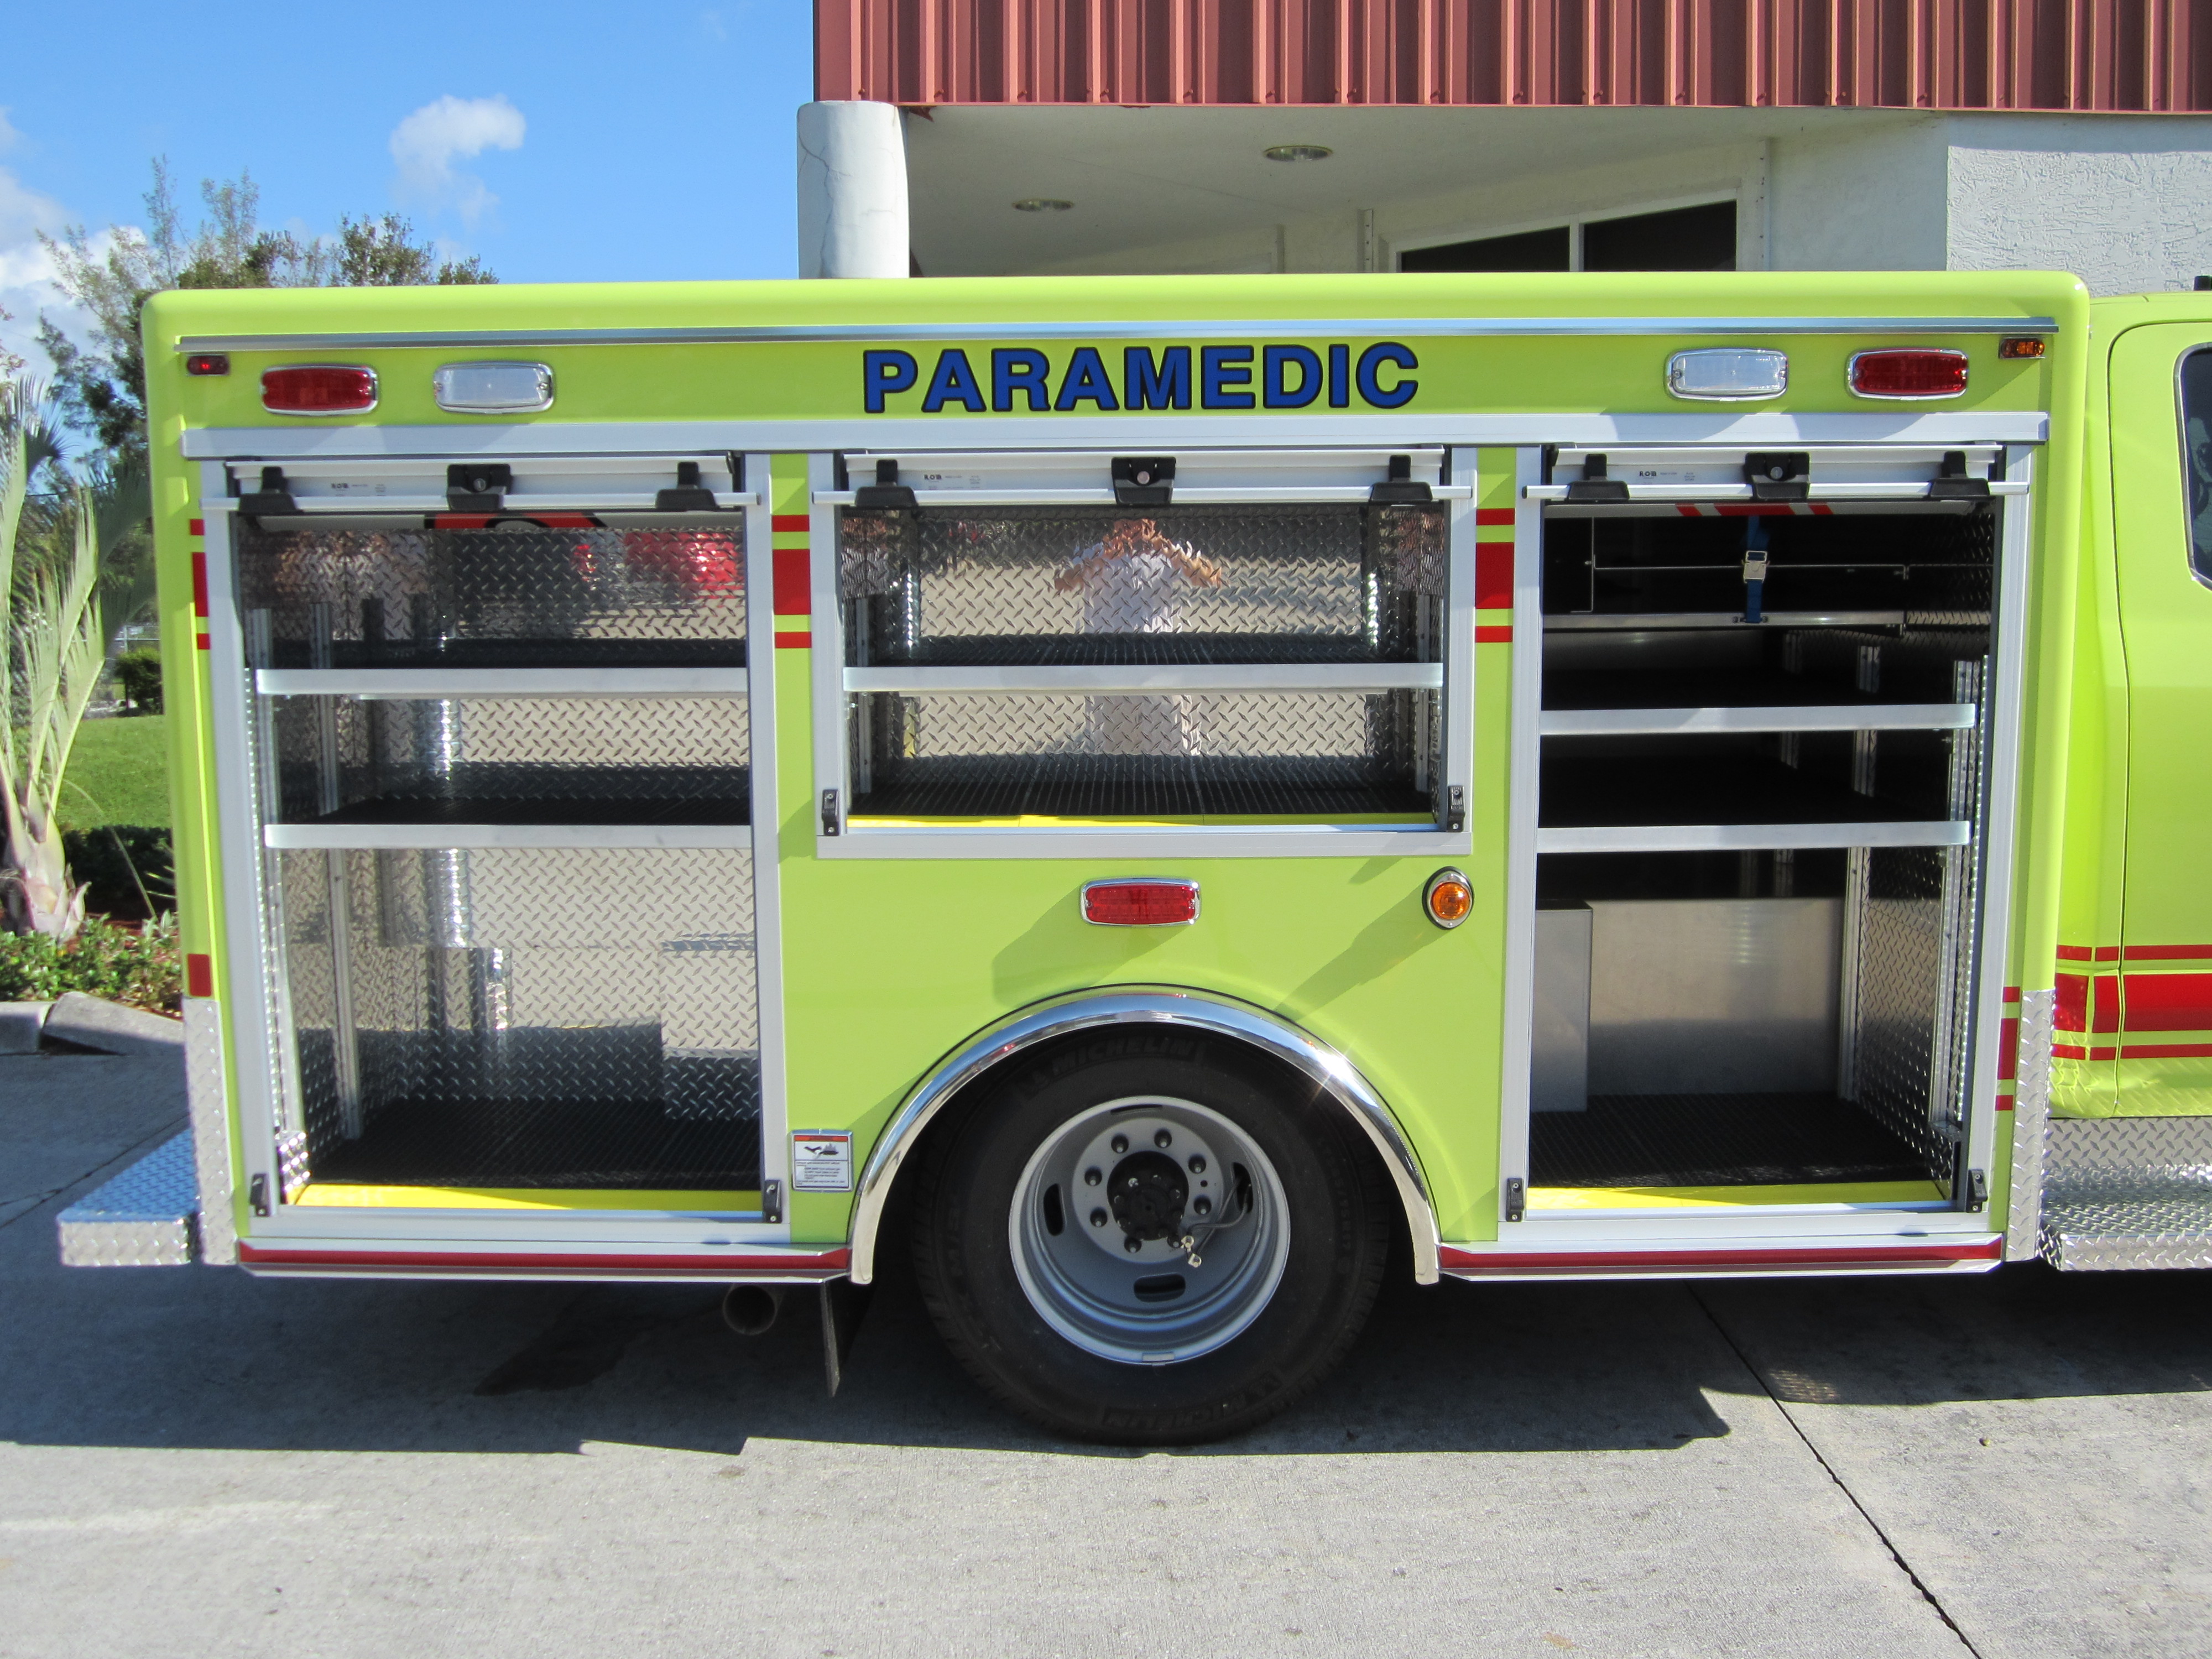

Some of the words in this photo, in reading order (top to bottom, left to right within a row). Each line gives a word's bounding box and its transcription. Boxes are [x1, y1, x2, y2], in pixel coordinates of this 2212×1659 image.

[863, 341, 1420, 414] PARAMEDIC
[1052, 1036, 1194, 1076] MICHELIN
[1104, 1392, 1248, 1430] MICHELIN
